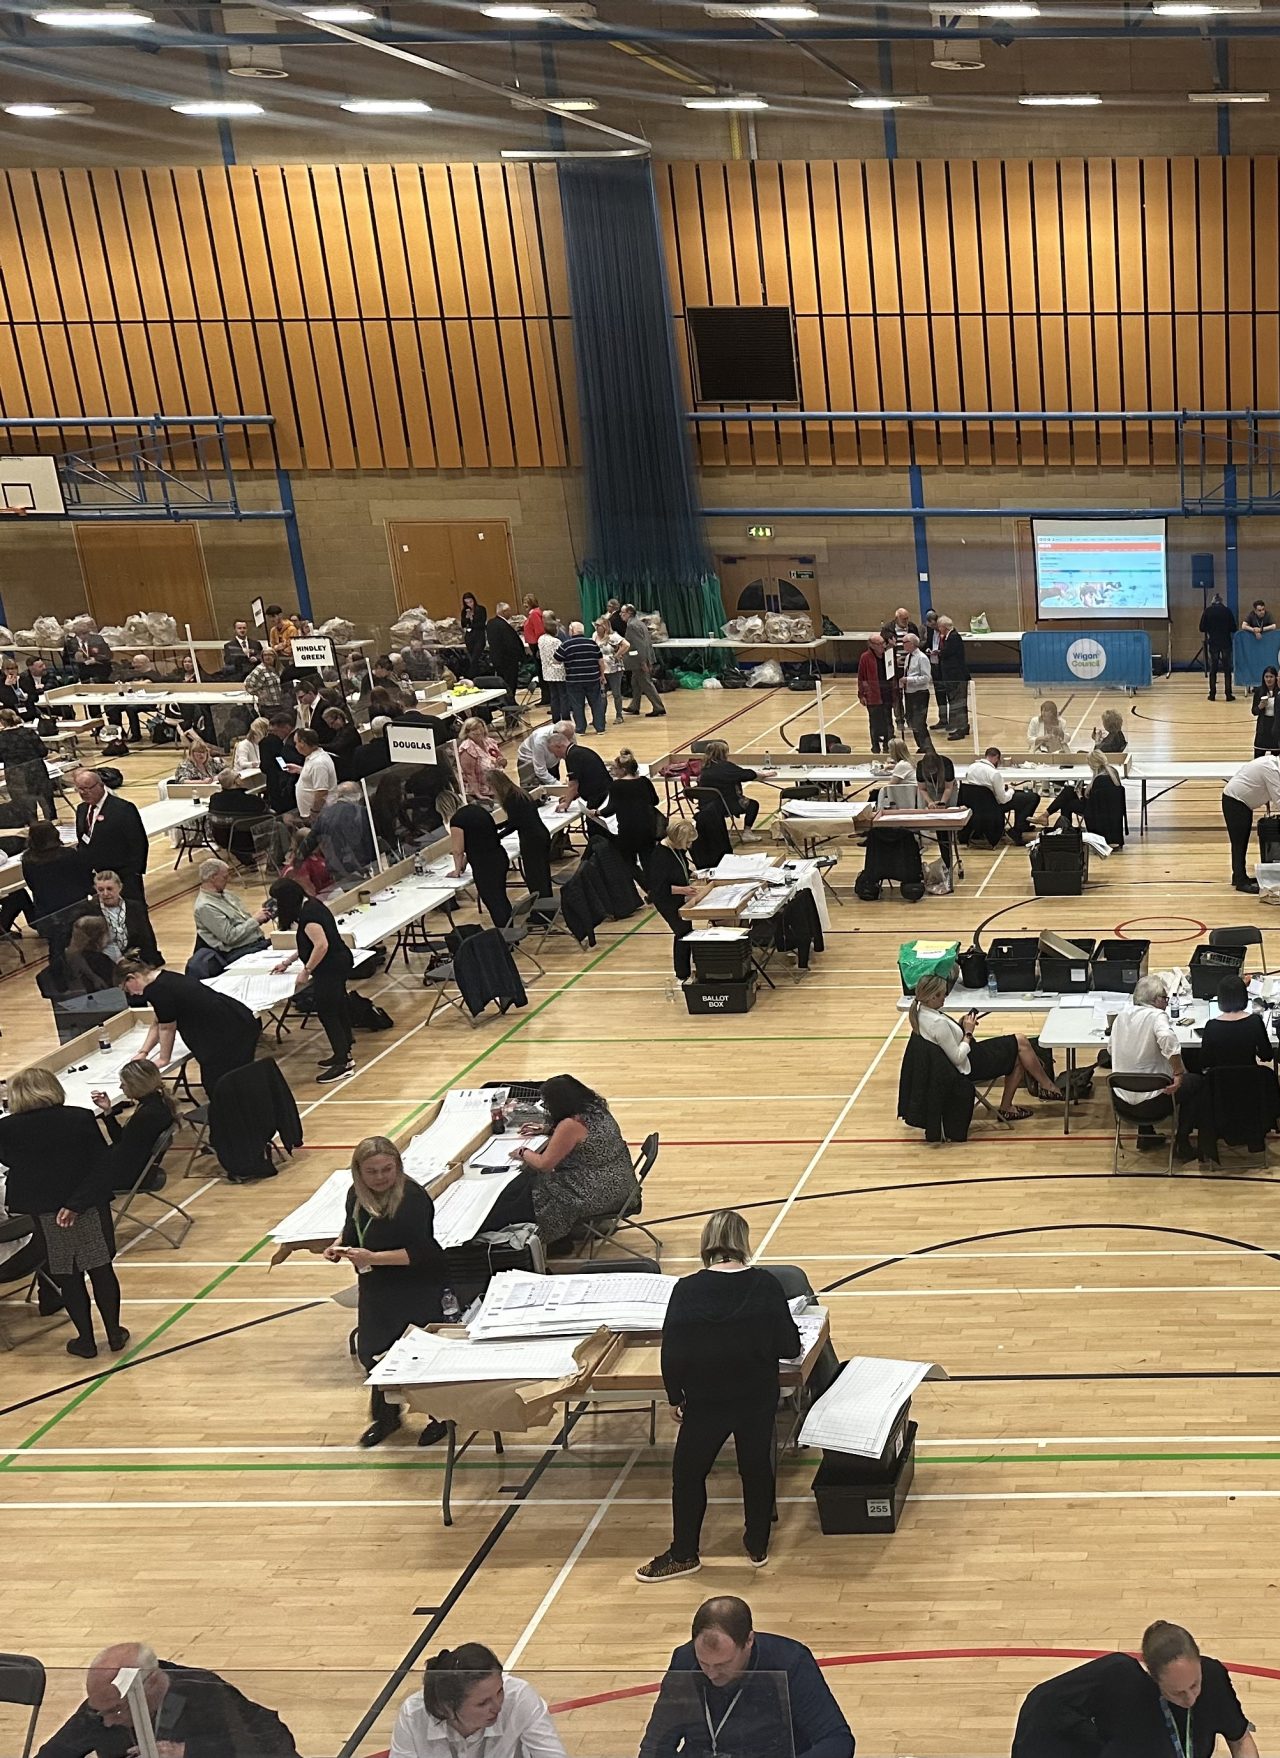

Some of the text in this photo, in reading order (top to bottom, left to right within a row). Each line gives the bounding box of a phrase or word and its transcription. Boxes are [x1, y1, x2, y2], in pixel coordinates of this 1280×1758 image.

[1072, 652, 1098, 661] Wigan
[392, 740, 432, 750] DOUGLAS
[870, 1505, 889, 1513] 255
